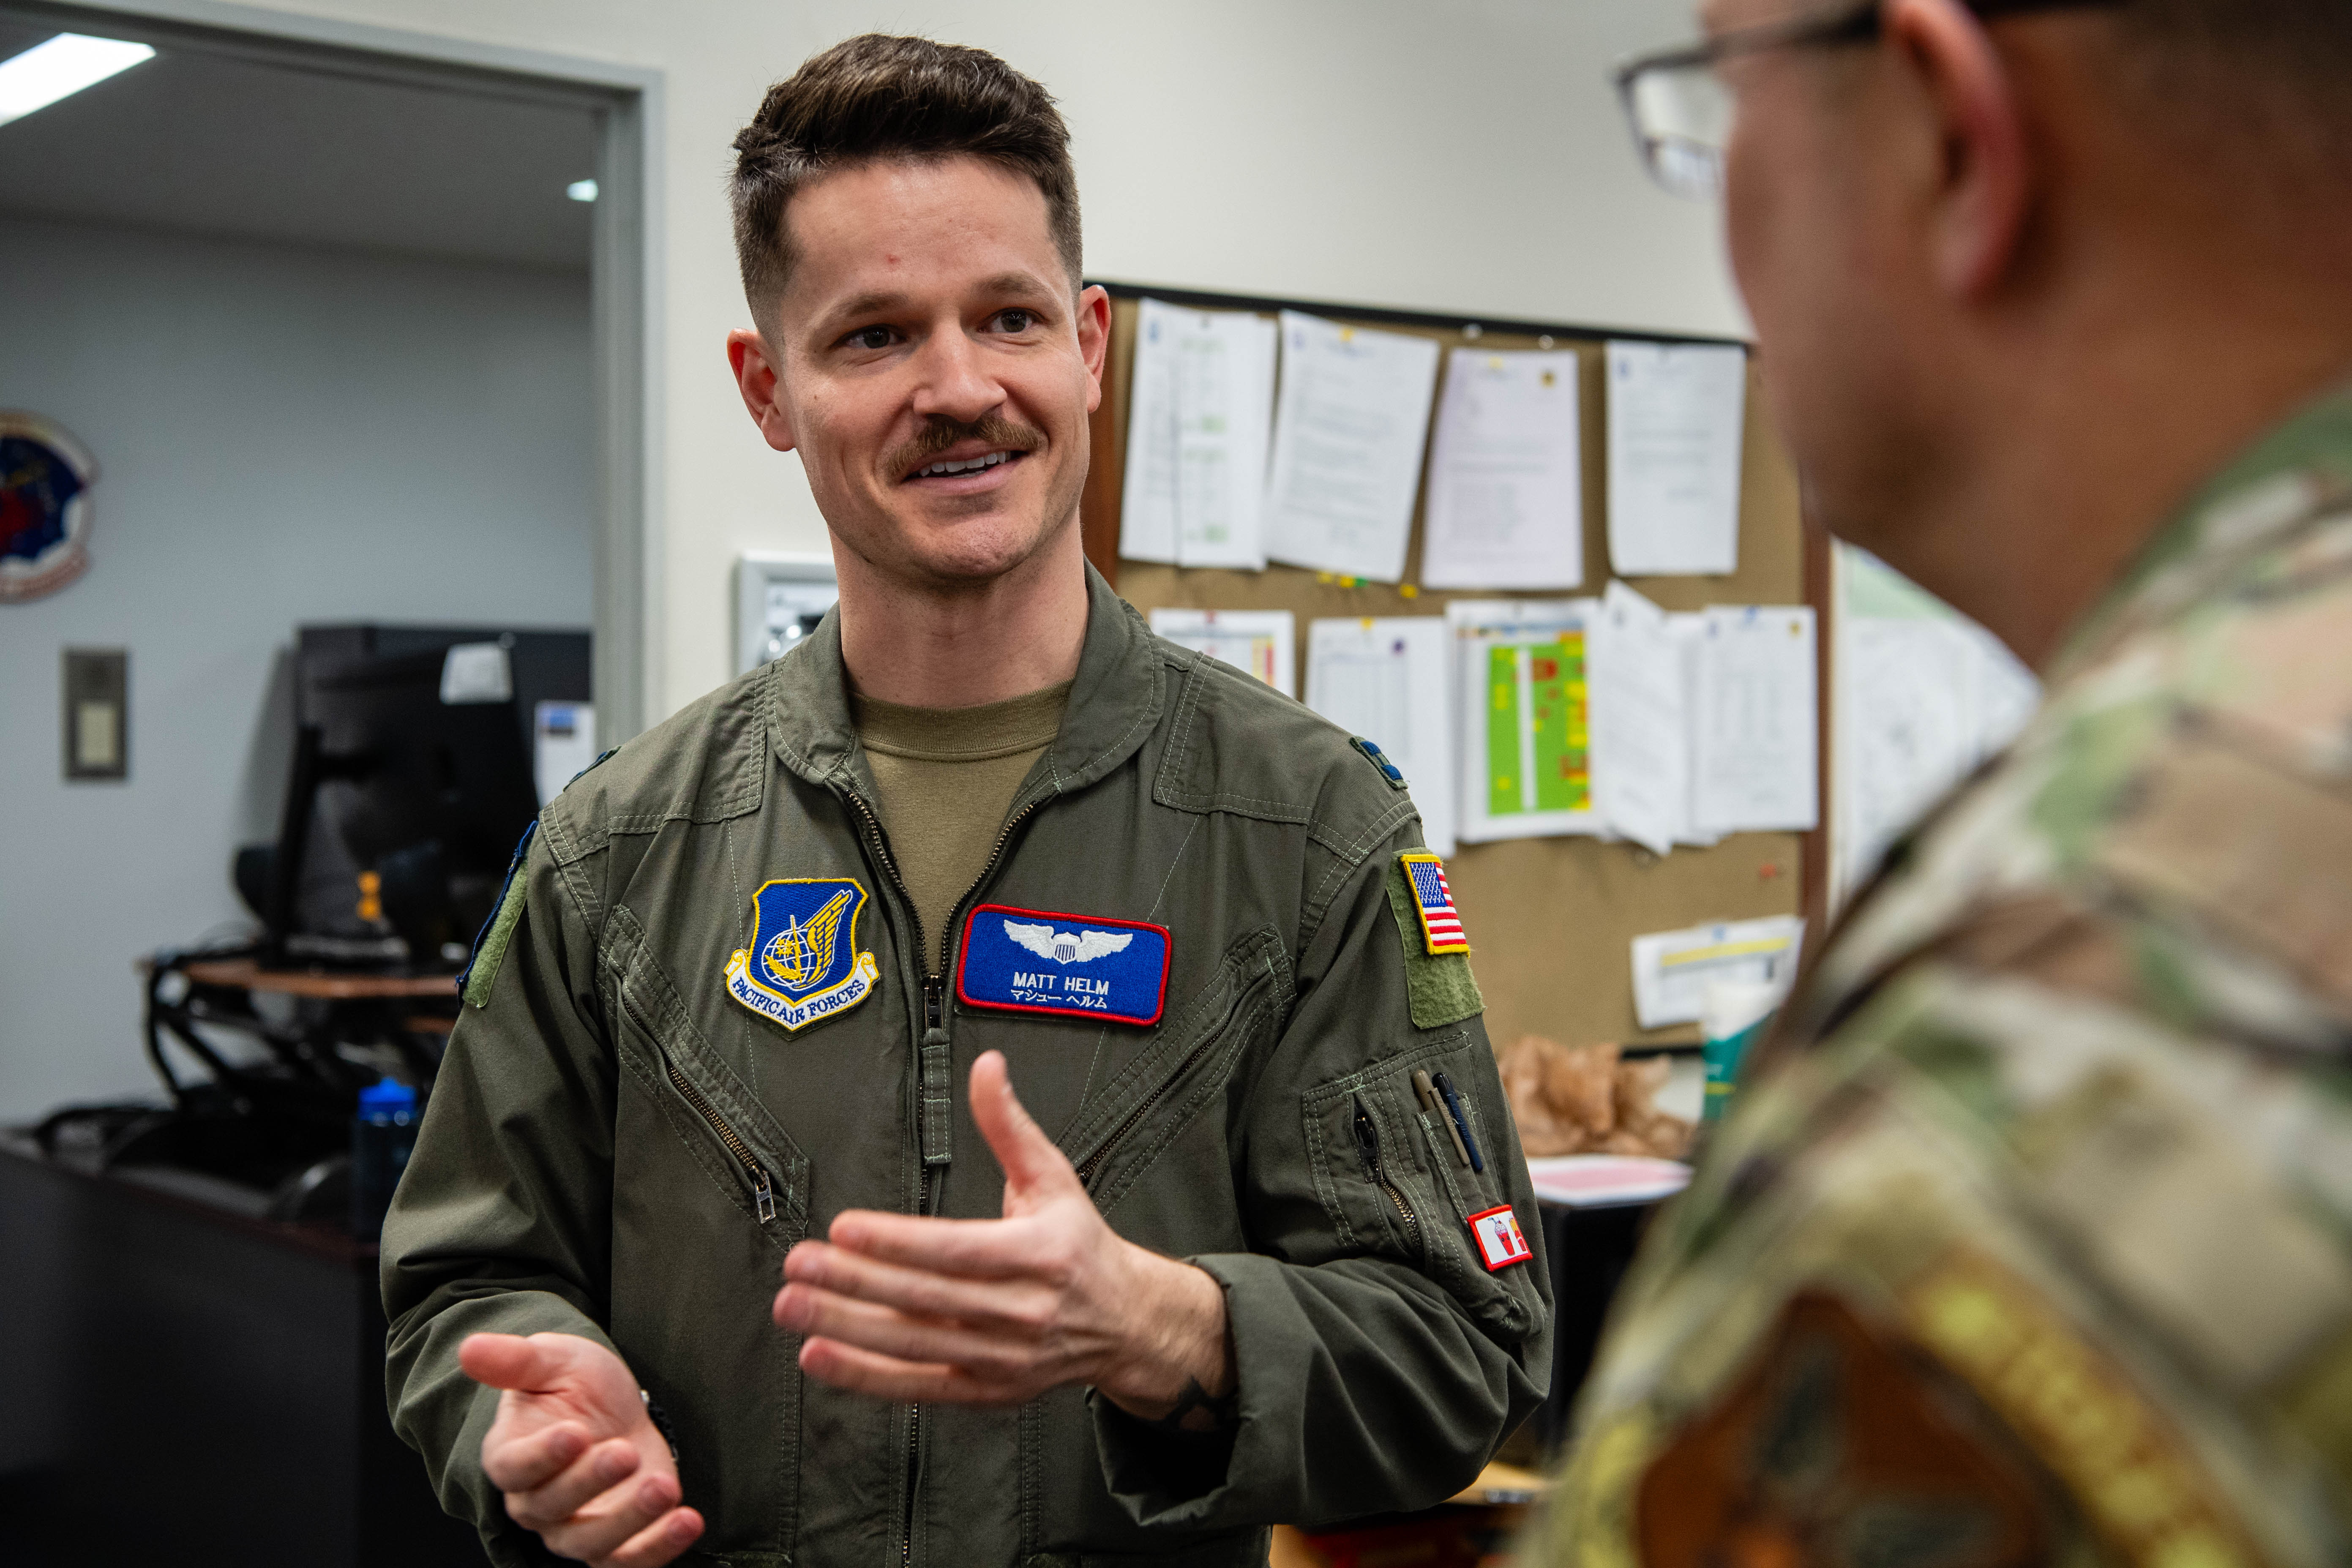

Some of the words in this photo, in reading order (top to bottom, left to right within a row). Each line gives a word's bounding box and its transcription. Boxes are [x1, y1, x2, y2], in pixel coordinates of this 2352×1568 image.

[1013, 971, 1057, 989] MATT
[1064, 976, 1109, 995] HELM
[732, 976, 780, 1014] PACIFIC
[778, 1007, 805, 1025] AIR
[807, 979, 865, 1016] FORCES
[1066, 995, 1107, 1009] ヘルム
